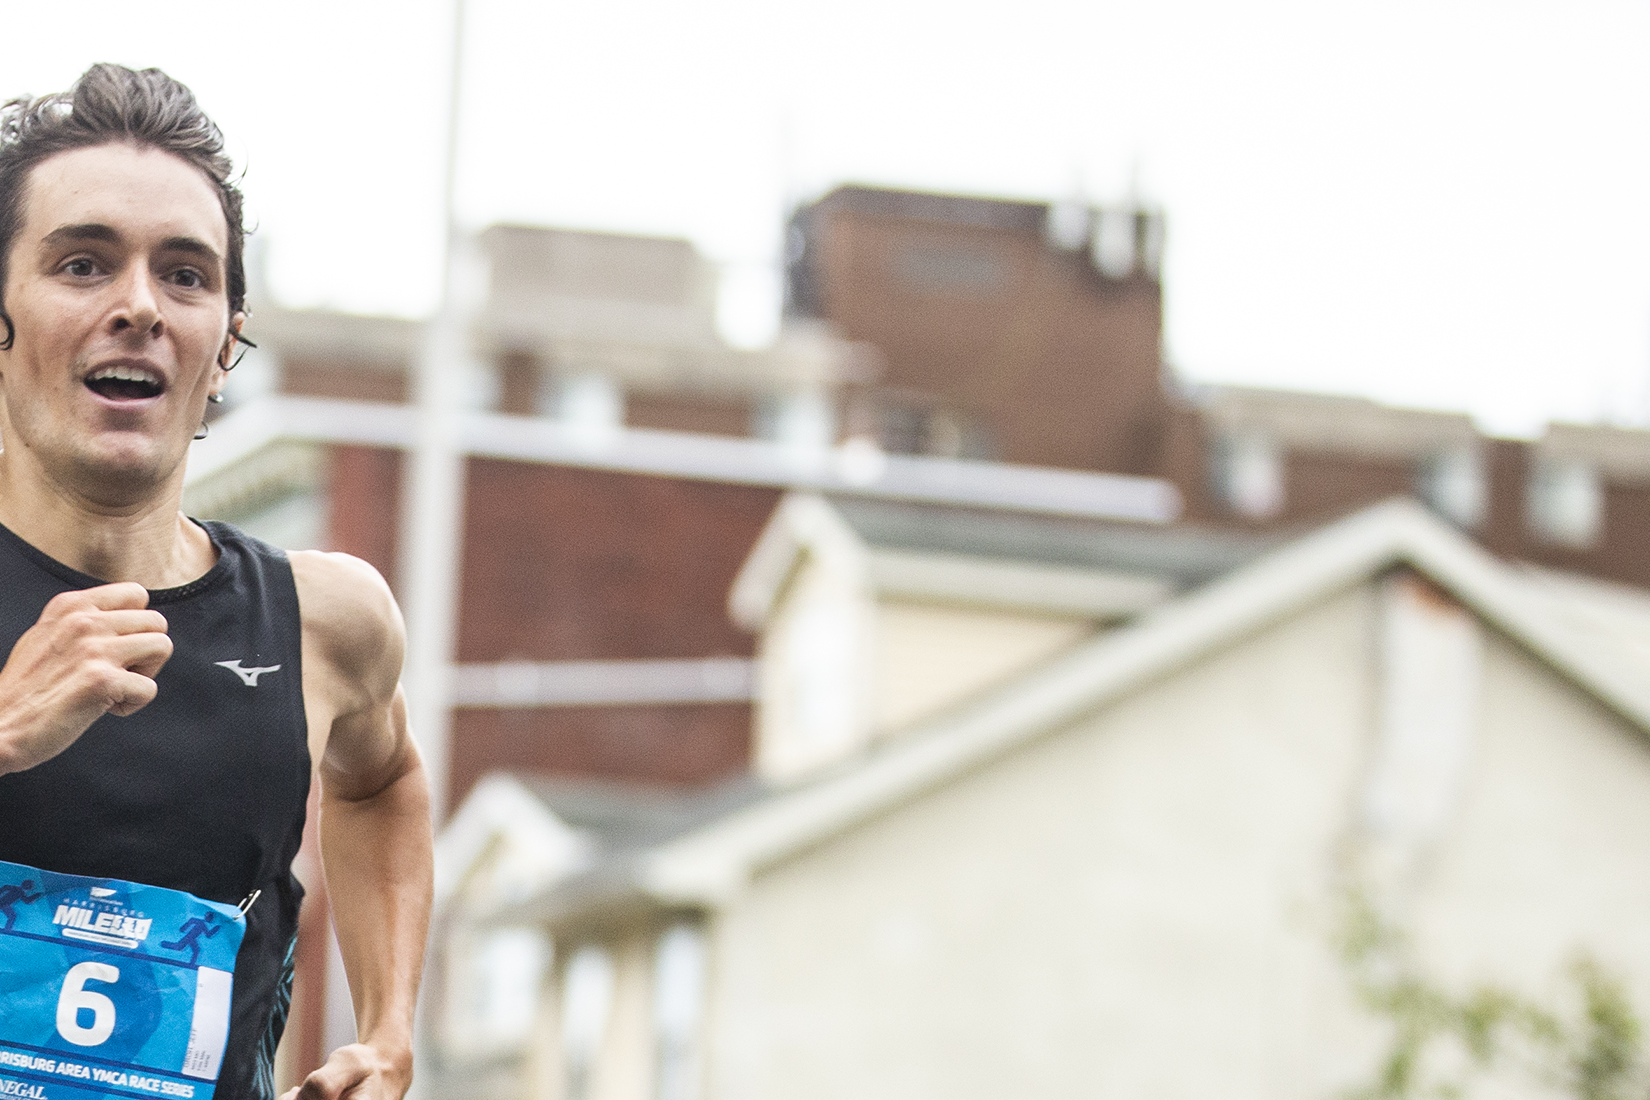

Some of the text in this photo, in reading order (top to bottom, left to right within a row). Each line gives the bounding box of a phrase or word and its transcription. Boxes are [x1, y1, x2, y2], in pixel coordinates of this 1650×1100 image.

[56, 961, 120, 1047] 6
[55, 1061, 91, 1079] AREA
[92, 1067, 128, 1086] YMCA
[128, 1074, 161, 1093] RACE
[161, 1081, 195, 1098] SERIES
